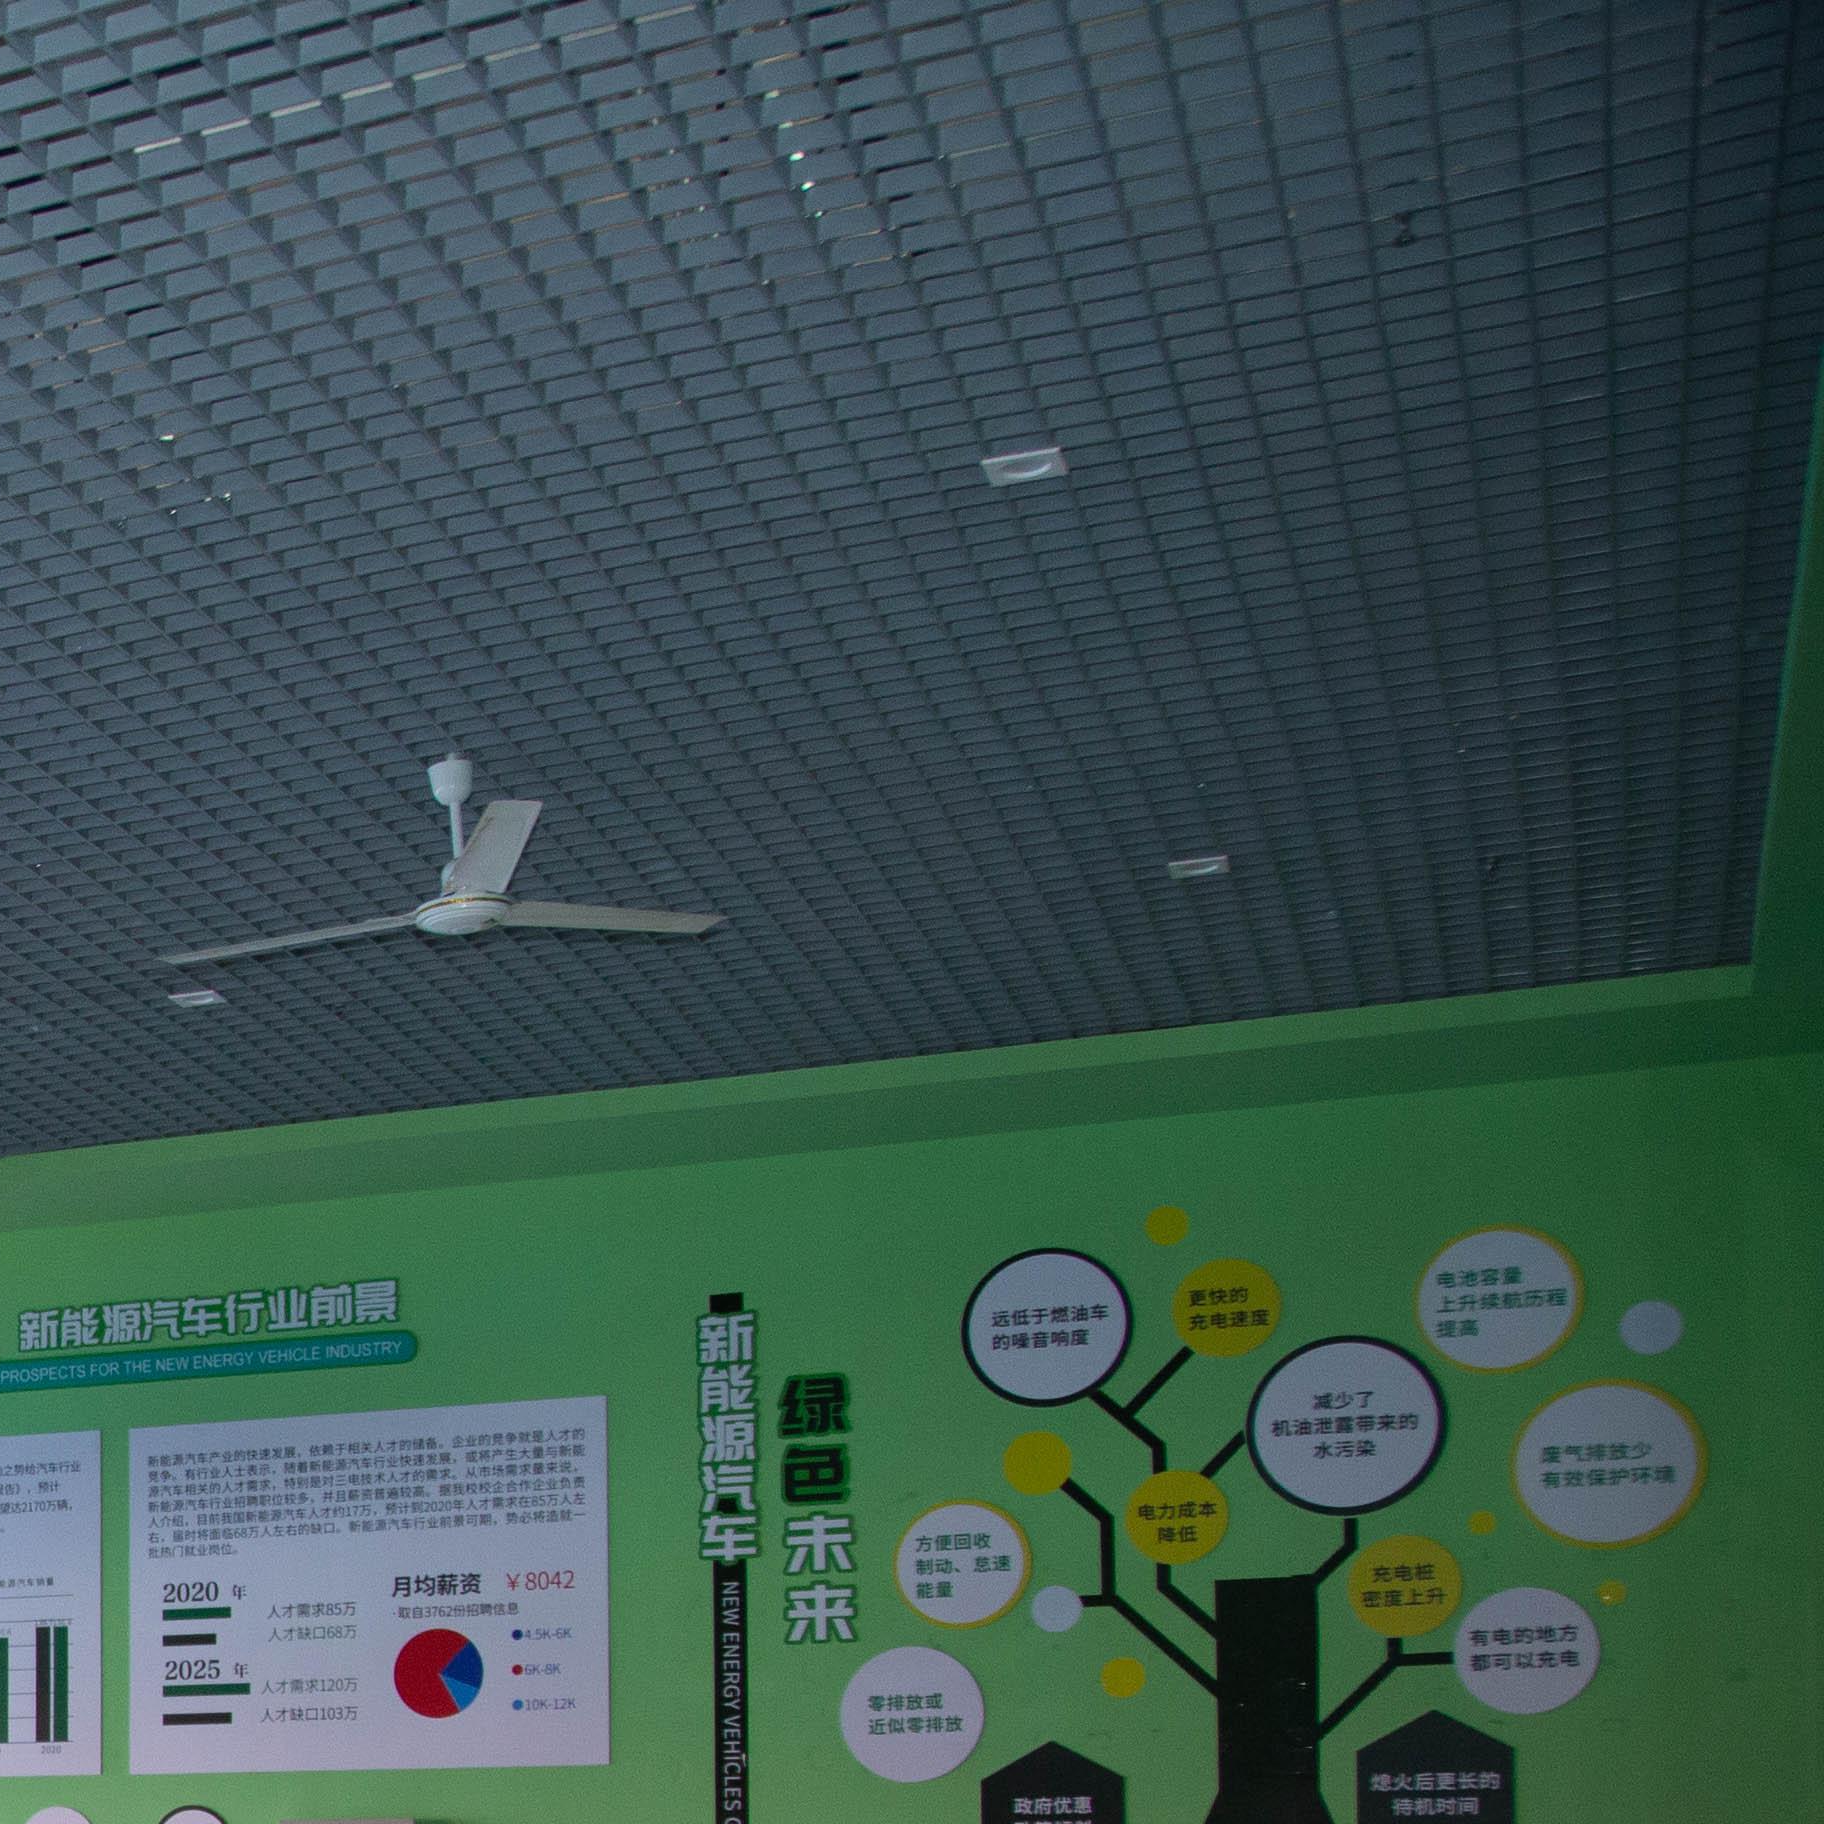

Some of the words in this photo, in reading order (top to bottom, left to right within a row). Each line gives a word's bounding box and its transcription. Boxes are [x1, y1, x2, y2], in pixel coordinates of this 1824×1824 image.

[1436, 1266, 1523, 1288] 电池容量
[1188, 1287, 1249, 1307] 更快的
[19, 1280, 398, 1352] 新能源汽车行业前景
[992, 1304, 1109, 1328] 远低于燃油车
[1188, 1309, 1270, 1331] 充电速度
[992, 1328, 1090, 1350] 的噪音响度
[1436, 1319, 1479, 1338] 提高
[0, 1364, 87, 1384] PROSPECTS
[90, 1361, 120, 1376] FOR
[125, 1359, 152, 1374] THE
[155, 1356, 190, 1372] NEW
[192, 1352, 252, 1369] ENERGY
[258, 1346, 322, 1365] VEHICLE
[326, 1340, 402, 1360] INDUSTRY
[1312, 1391, 1374, 1410] 减少了
[1271, 1413, 1419, 1437] 机油泄露带来的
[698, 1312, 757, 1562] 新能源汽车
[1313, 1440, 1376, 1459] 水污染
[1541, 1443, 1652, 1464] 废气排放少
[1541, 1465, 1676, 1488] 有效保护环境
[779, 1376, 854, 1643] 绿色未来
[1137, 1501, 1217, 1521] 电力成本
[915, 1533, 992, 1553] 方便回收
[1157, 1526, 1198, 1544] 降低
[915, 1555, 1012, 1575] 制动、怠速
[1372, 1563, 1435, 1583] 充电桩
[163, 1581, 219, 1602] 2020
[232, 1583, 248, 1600] 年
[392, 1572, 482, 1598] 月均薪资
[915, 1581, 954, 1599] 能量
[722, 1582, 740, 1626] NEW
[1361, 1587, 1449, 1608] 密度上升
[267, 1602, 357, 1619] 人才需求85万
[267, 1625, 357, 1642] 人才缺口68万
[524, 1627, 572, 1641] 4.5K-6K
[1468, 1624, 1579, 1646] 有电的地方
[164, 1659, 221, 1681] 2025
[233, 1662, 249, 1679] 年
[722, 1632, 741, 1707] ENERGY
[1469, 1650, 1580, 1672] 都可以充电
[261, 1678, 358, 1696] 人才需求120万
[524, 1699, 577, 1712] 10K-12K
[867, 1693, 944, 1712] 零排放或
[260, 1706, 358, 1723] 人才缺口103万
[867, 1715, 964, 1736] 近似零排放
[722, 1710, 742, 1811] VEHICLES
[1370, 1771, 1501, 1792] 熄火后更长的
[1013, 1796, 1093, 1815] 政府优惠
[1392, 1797, 1480, 1816] 待机时间
